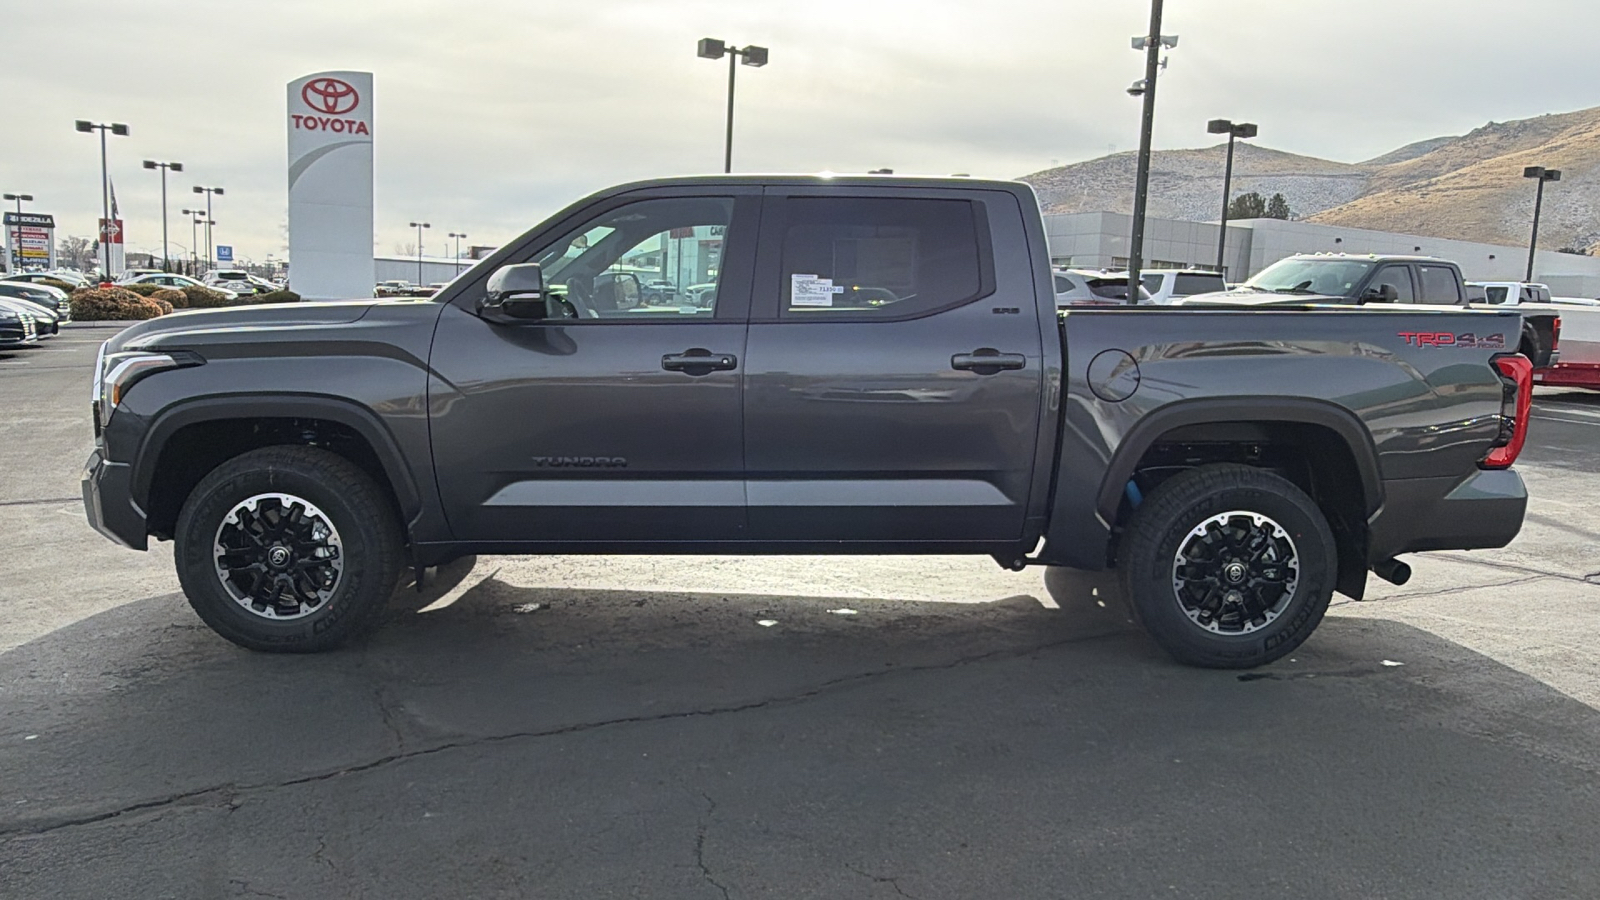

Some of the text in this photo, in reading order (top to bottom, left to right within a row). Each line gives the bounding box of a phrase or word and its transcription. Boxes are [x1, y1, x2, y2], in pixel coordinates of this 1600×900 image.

[291, 114, 369, 135] TOYOTA
[1397, 332, 1505, 348] TRD 4x4
[531, 456, 628, 467] TUNDRA
